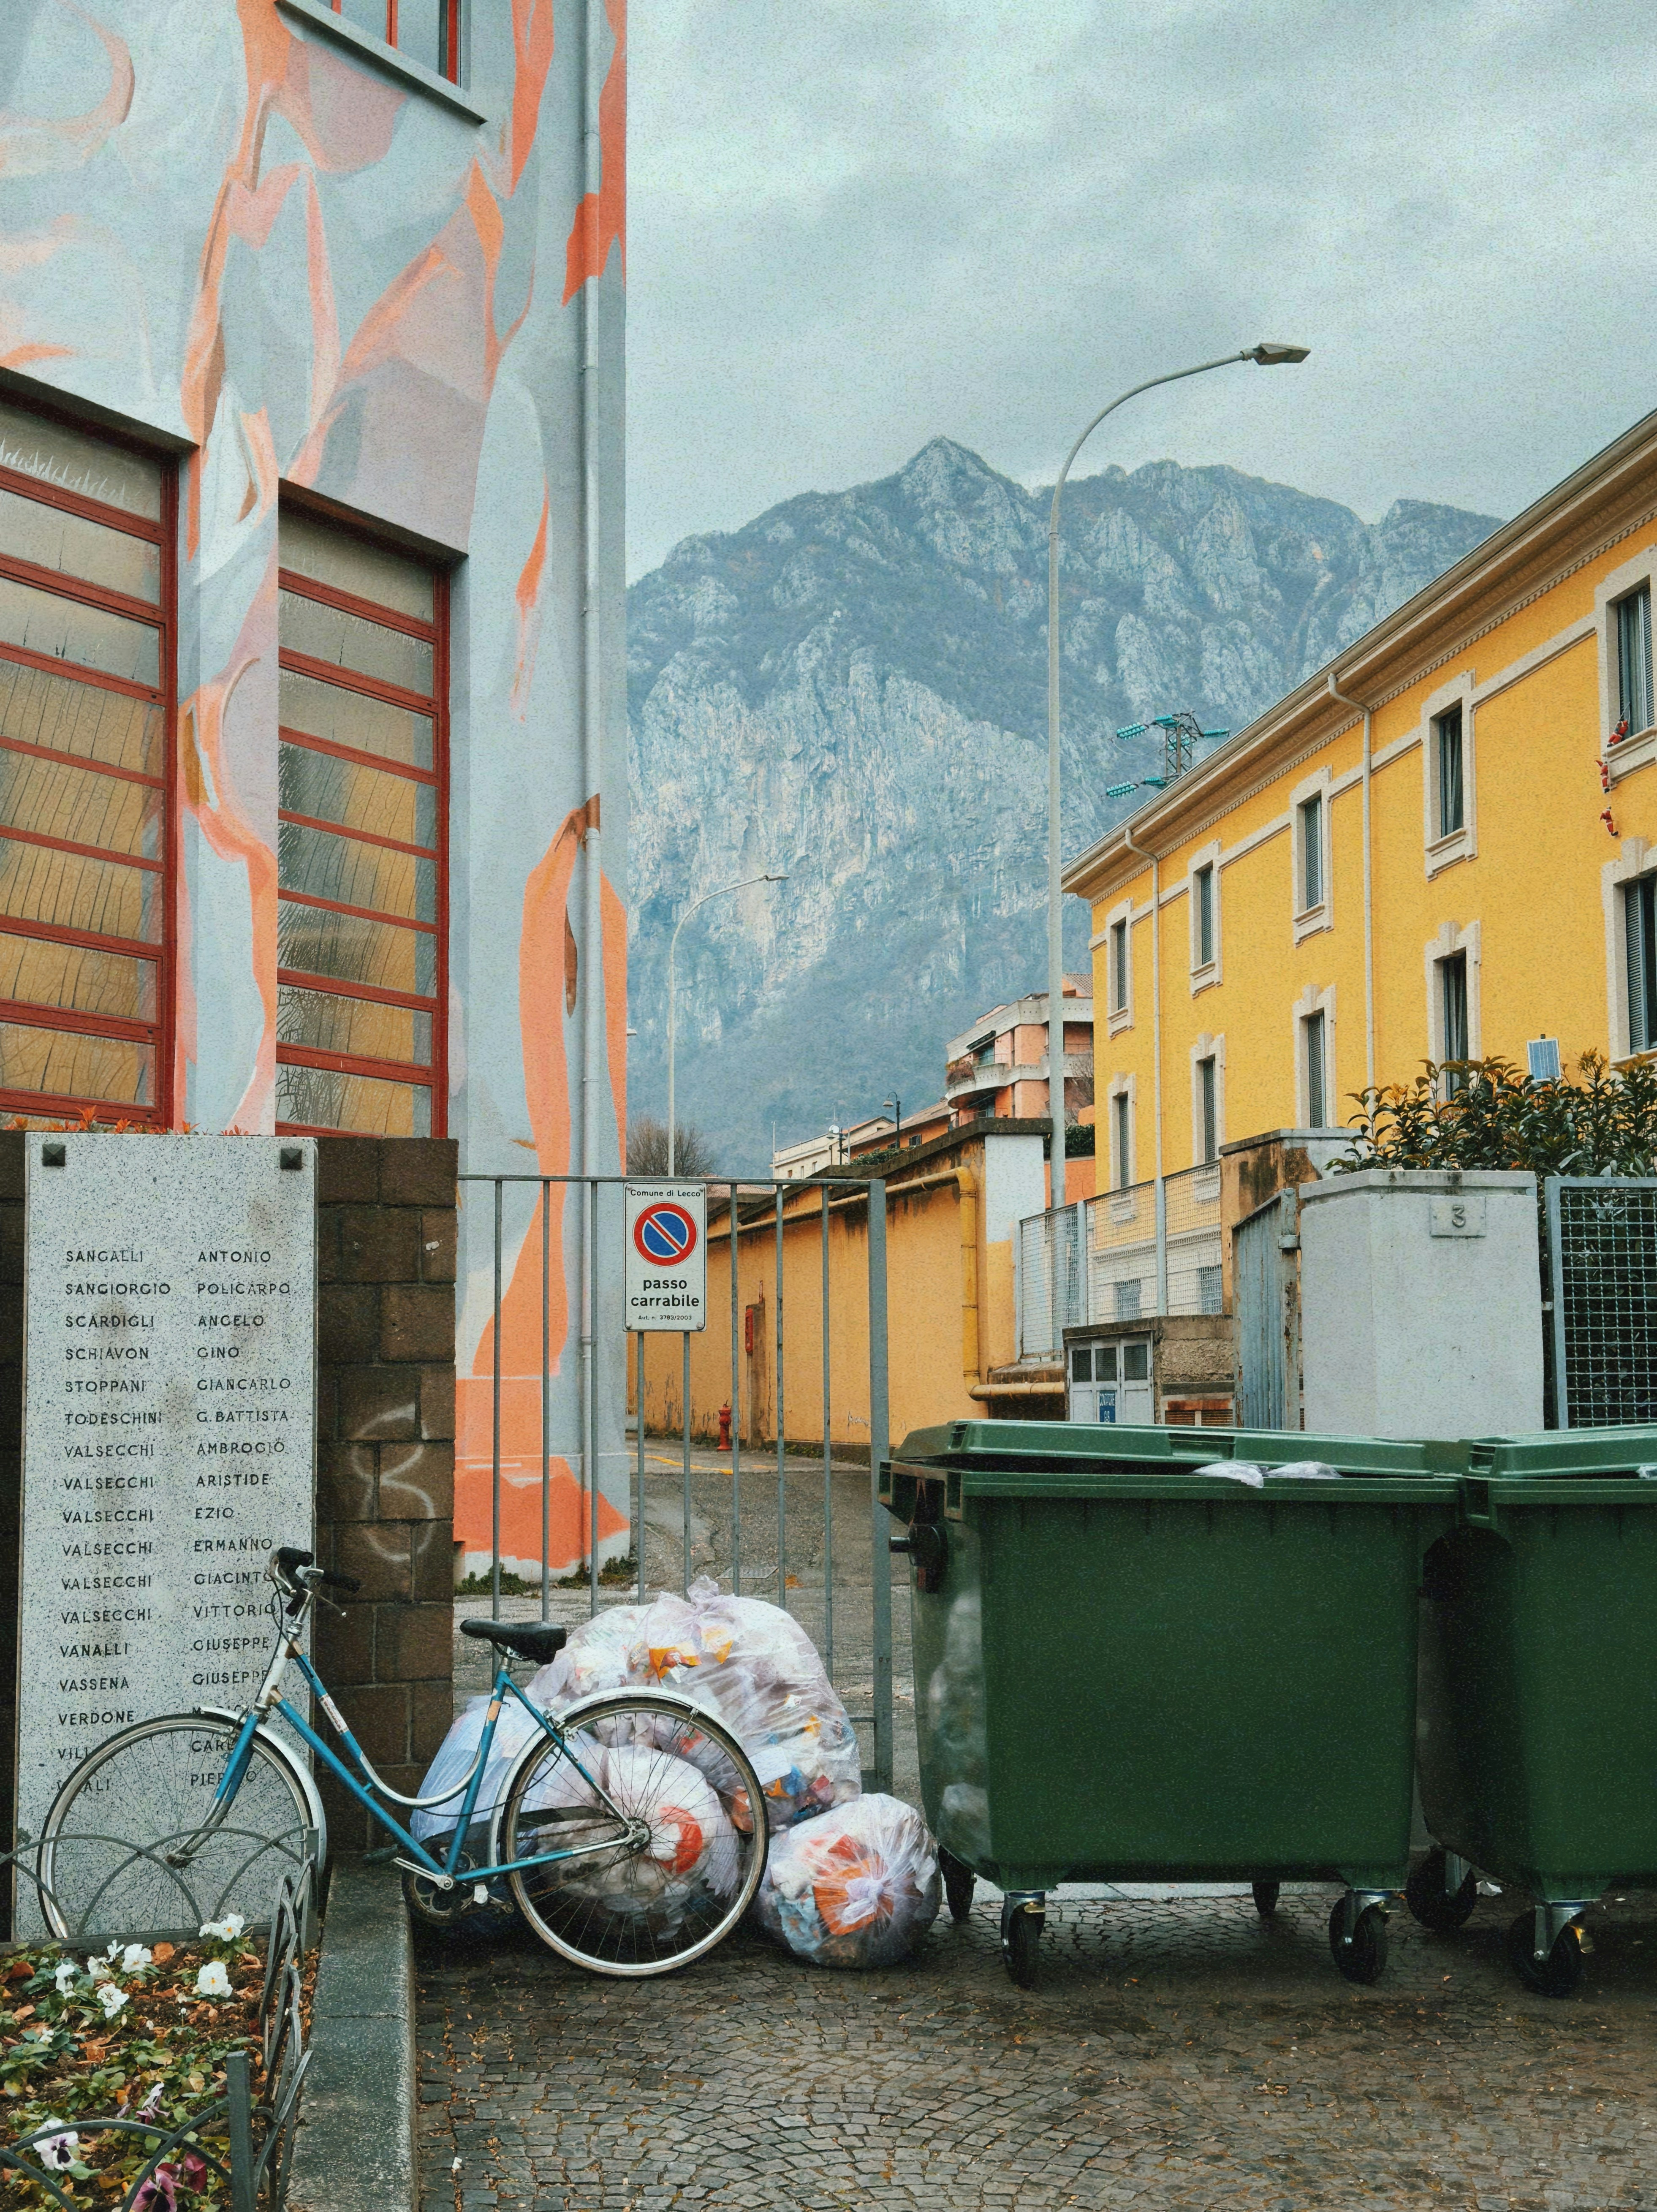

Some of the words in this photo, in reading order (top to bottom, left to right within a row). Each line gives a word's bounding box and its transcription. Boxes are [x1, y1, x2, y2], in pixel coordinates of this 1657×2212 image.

[1451, 1205, 1467, 1228] 3
[66, 1250, 144, 1263] SANGALLI
[198, 1250, 272, 1263] ANTONIO
[65, 1283, 171, 1295] SANGIORGIO
[197, 1283, 290, 1295] POLICARPO
[643, 1279, 687, 1291] passo
[630, 1294, 700, 1307] carrabile
[65, 1315, 154, 1328] SCARDIGLI
[198, 1315, 264, 1327] ANGELO
[65, 1347, 149, 1361] SCHIAVON
[197, 1347, 239, 1359] GINO
[65, 1381, 145, 1393] STOPPANI
[197, 1378, 291, 1391] GIANCARLO
[65, 1412, 163, 1425] TODESCHINI
[64, 1445, 154, 1458] VALSECCHI
[197, 1441, 285, 1455] AMBROGIO
[63, 1477, 154, 1490] VALSECCHI
[196, 1473, 270, 1487] ARISTIDE
[62, 1509, 153, 1523] VALSECCHI
[195, 1507, 234, 1519] EZIO
[62, 1542, 152, 1556] VALSECCHI
[194, 1538, 273, 1552] ERMANNO
[61, 1575, 152, 1590] VALSECCHI
[61, 1608, 152, 1624] VALSECCHI
[193, 1603, 276, 1618] VITTORIO
[60, 1643, 128, 1658] VANALLI
[193, 1637, 269, 1651] GIUSEPPE
[60, 1677, 130, 1692] VASSENA
[58, 1710, 135, 1726] VERDONE
